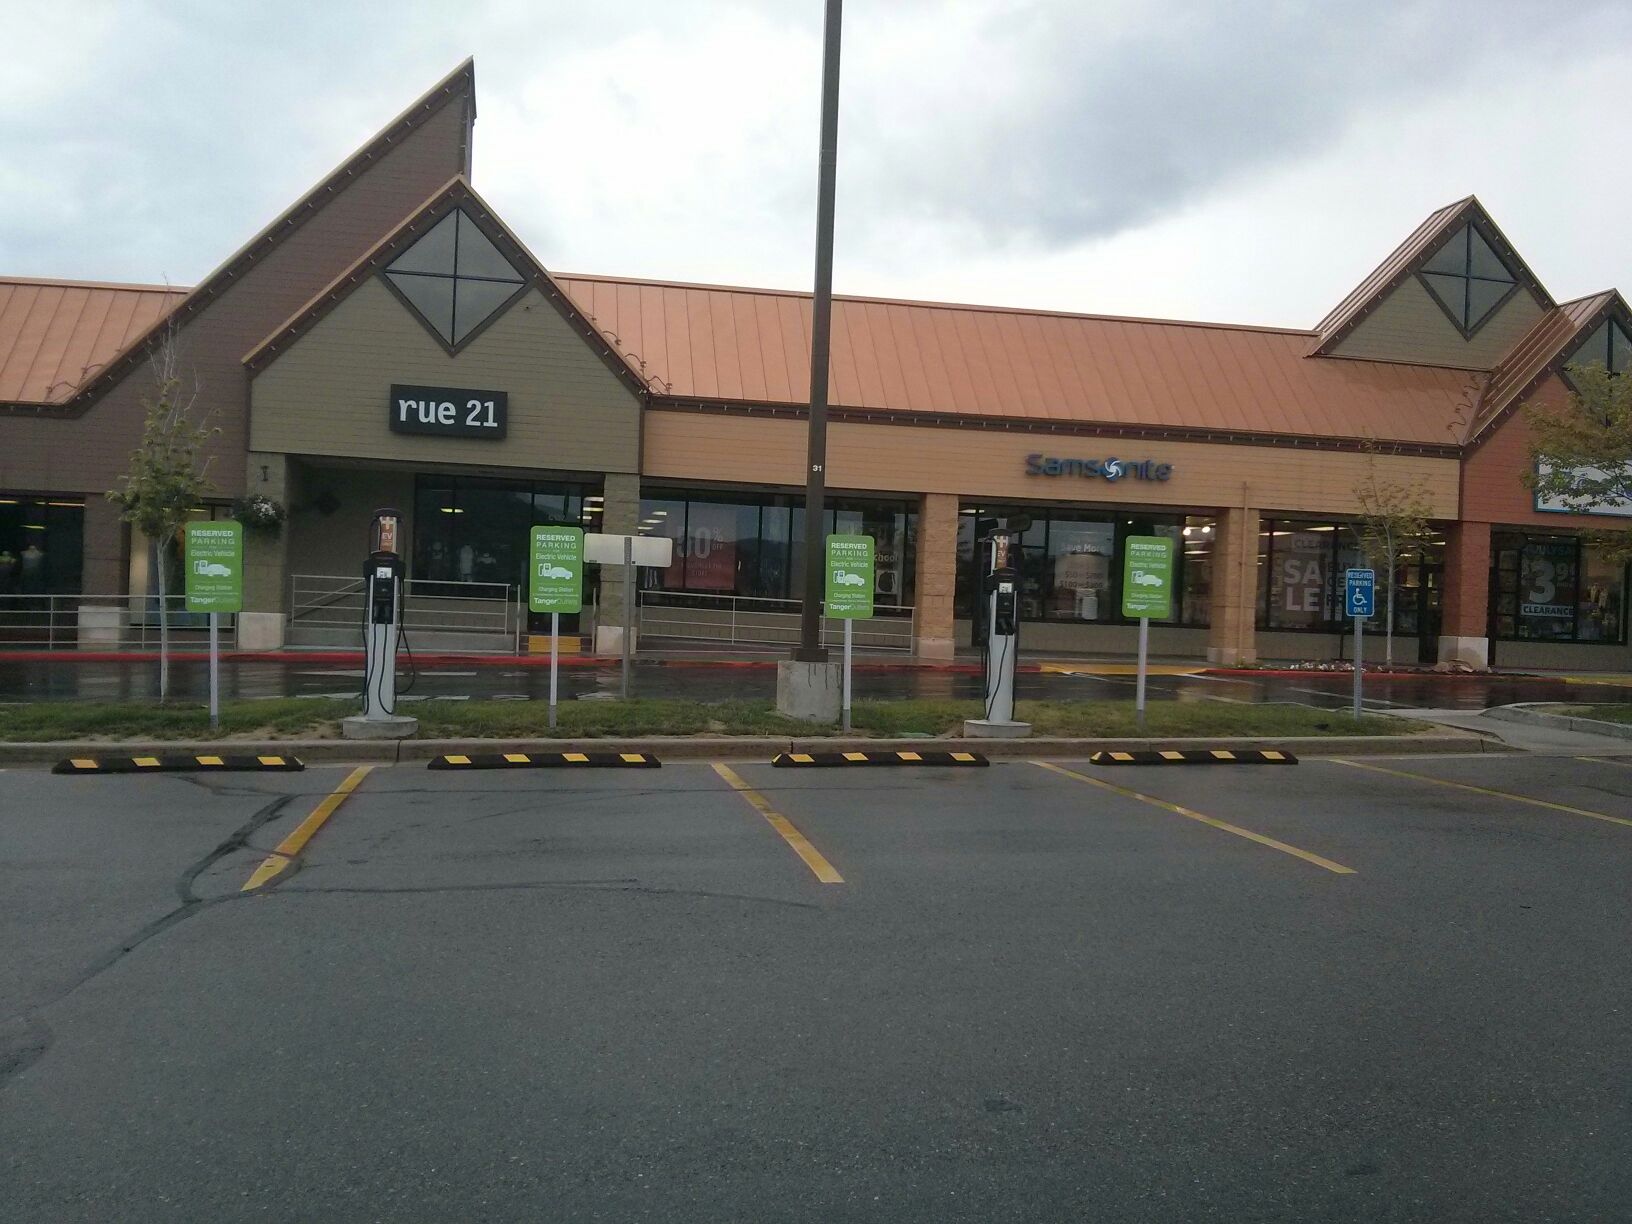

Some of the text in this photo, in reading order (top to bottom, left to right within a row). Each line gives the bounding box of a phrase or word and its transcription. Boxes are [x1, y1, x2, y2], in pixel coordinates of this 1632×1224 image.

[398, 399, 498, 427] rue 21
[812, 464, 822, 472] 31
[1025, 453, 1173, 482] Samsonite
[191, 529, 234, 537] RESERVED
[381, 532, 393, 540] EV
[191, 537, 235, 545] PARKING
[536, 534, 576, 542] RESERVED
[536, 541, 577, 549] PARKING
[831, 542, 868, 550] RESERVED
[1130, 543, 1167, 551] RESERVED
[190, 549, 235, 557] Electric Vehicle
[535, 552, 577, 561] Electric Vehicle
[874, 552, 898, 562] chool
[1130, 551, 1167, 559] PARKING
[830, 560, 849, 568] Electric
[1347, 571, 1373, 579] RESERVED
[1349, 579, 1372, 587] PARKING
[1353, 606, 1368, 614] ONLY
[1523, 605, 1574, 616] CLEARANCE
